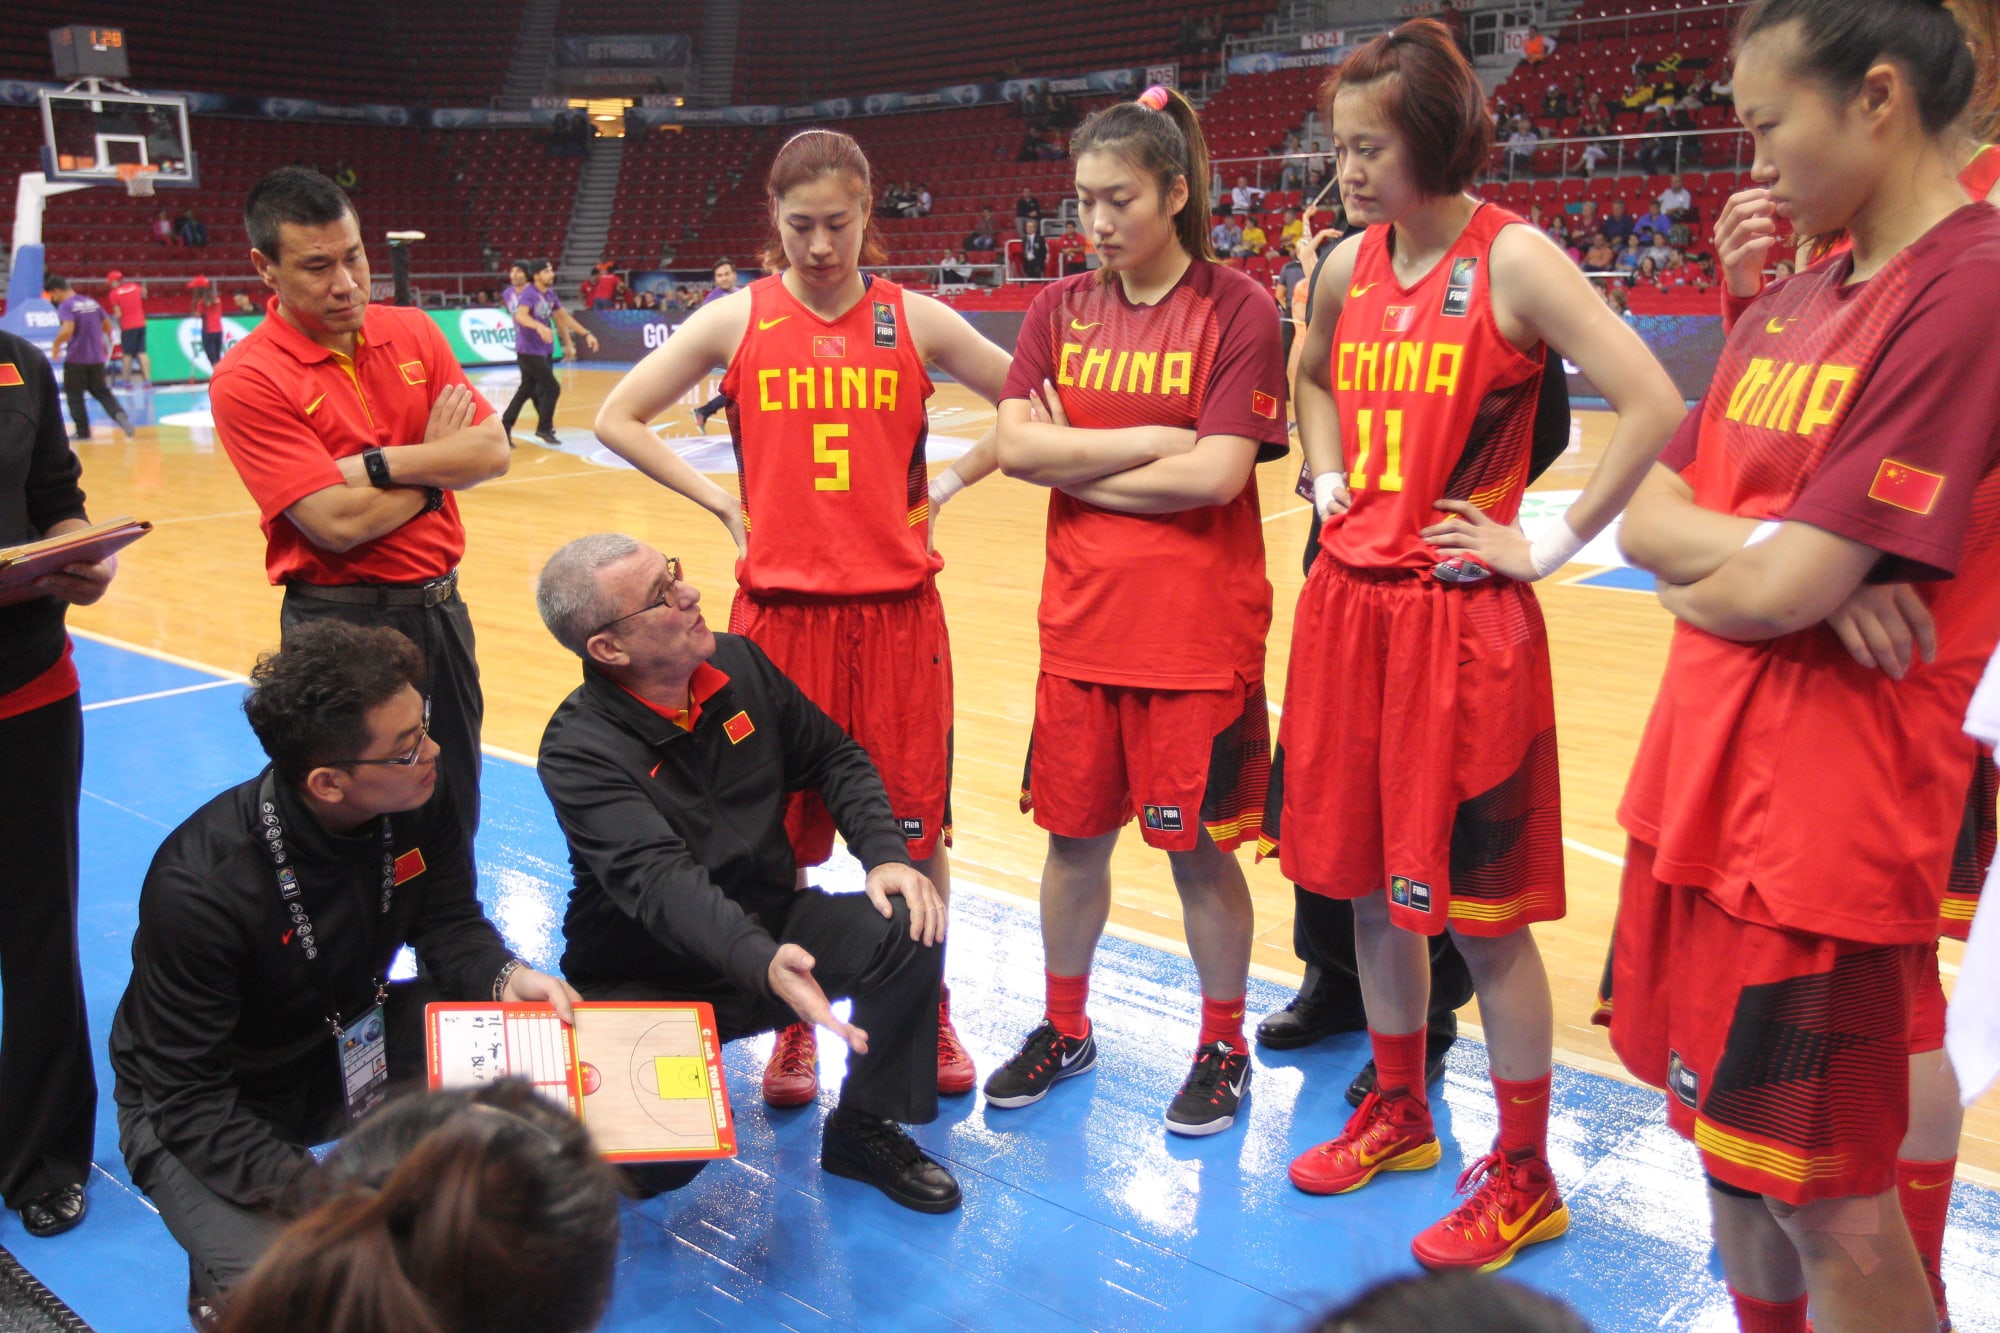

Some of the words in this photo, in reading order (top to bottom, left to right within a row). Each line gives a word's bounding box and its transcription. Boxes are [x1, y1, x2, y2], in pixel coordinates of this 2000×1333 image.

[1307, 32, 1338, 49] 104
[1506, 33, 1523, 49] 10
[1148, 69, 1173, 84] 105
[1449, 291, 1467, 301] FIBA
[26, 311, 60, 327] FIBA
[643, 323, 668, 348] GO
[877, 327, 893, 336] FIBA
[1058, 342, 1192, 395] CHINA
[1338, 341, 1464, 396] CHINA
[758, 367, 898, 411] CHINA
[813, 424, 850, 491] 5
[1349, 409, 1403, 492] 11
[1163, 809, 1179, 818] FIBA
[904, 821, 920, 829] FIBA
[1412, 884, 1429, 898] FIBA
[708, 1065, 721, 1089] TOM
[711, 1089, 727, 1129] MAHER
